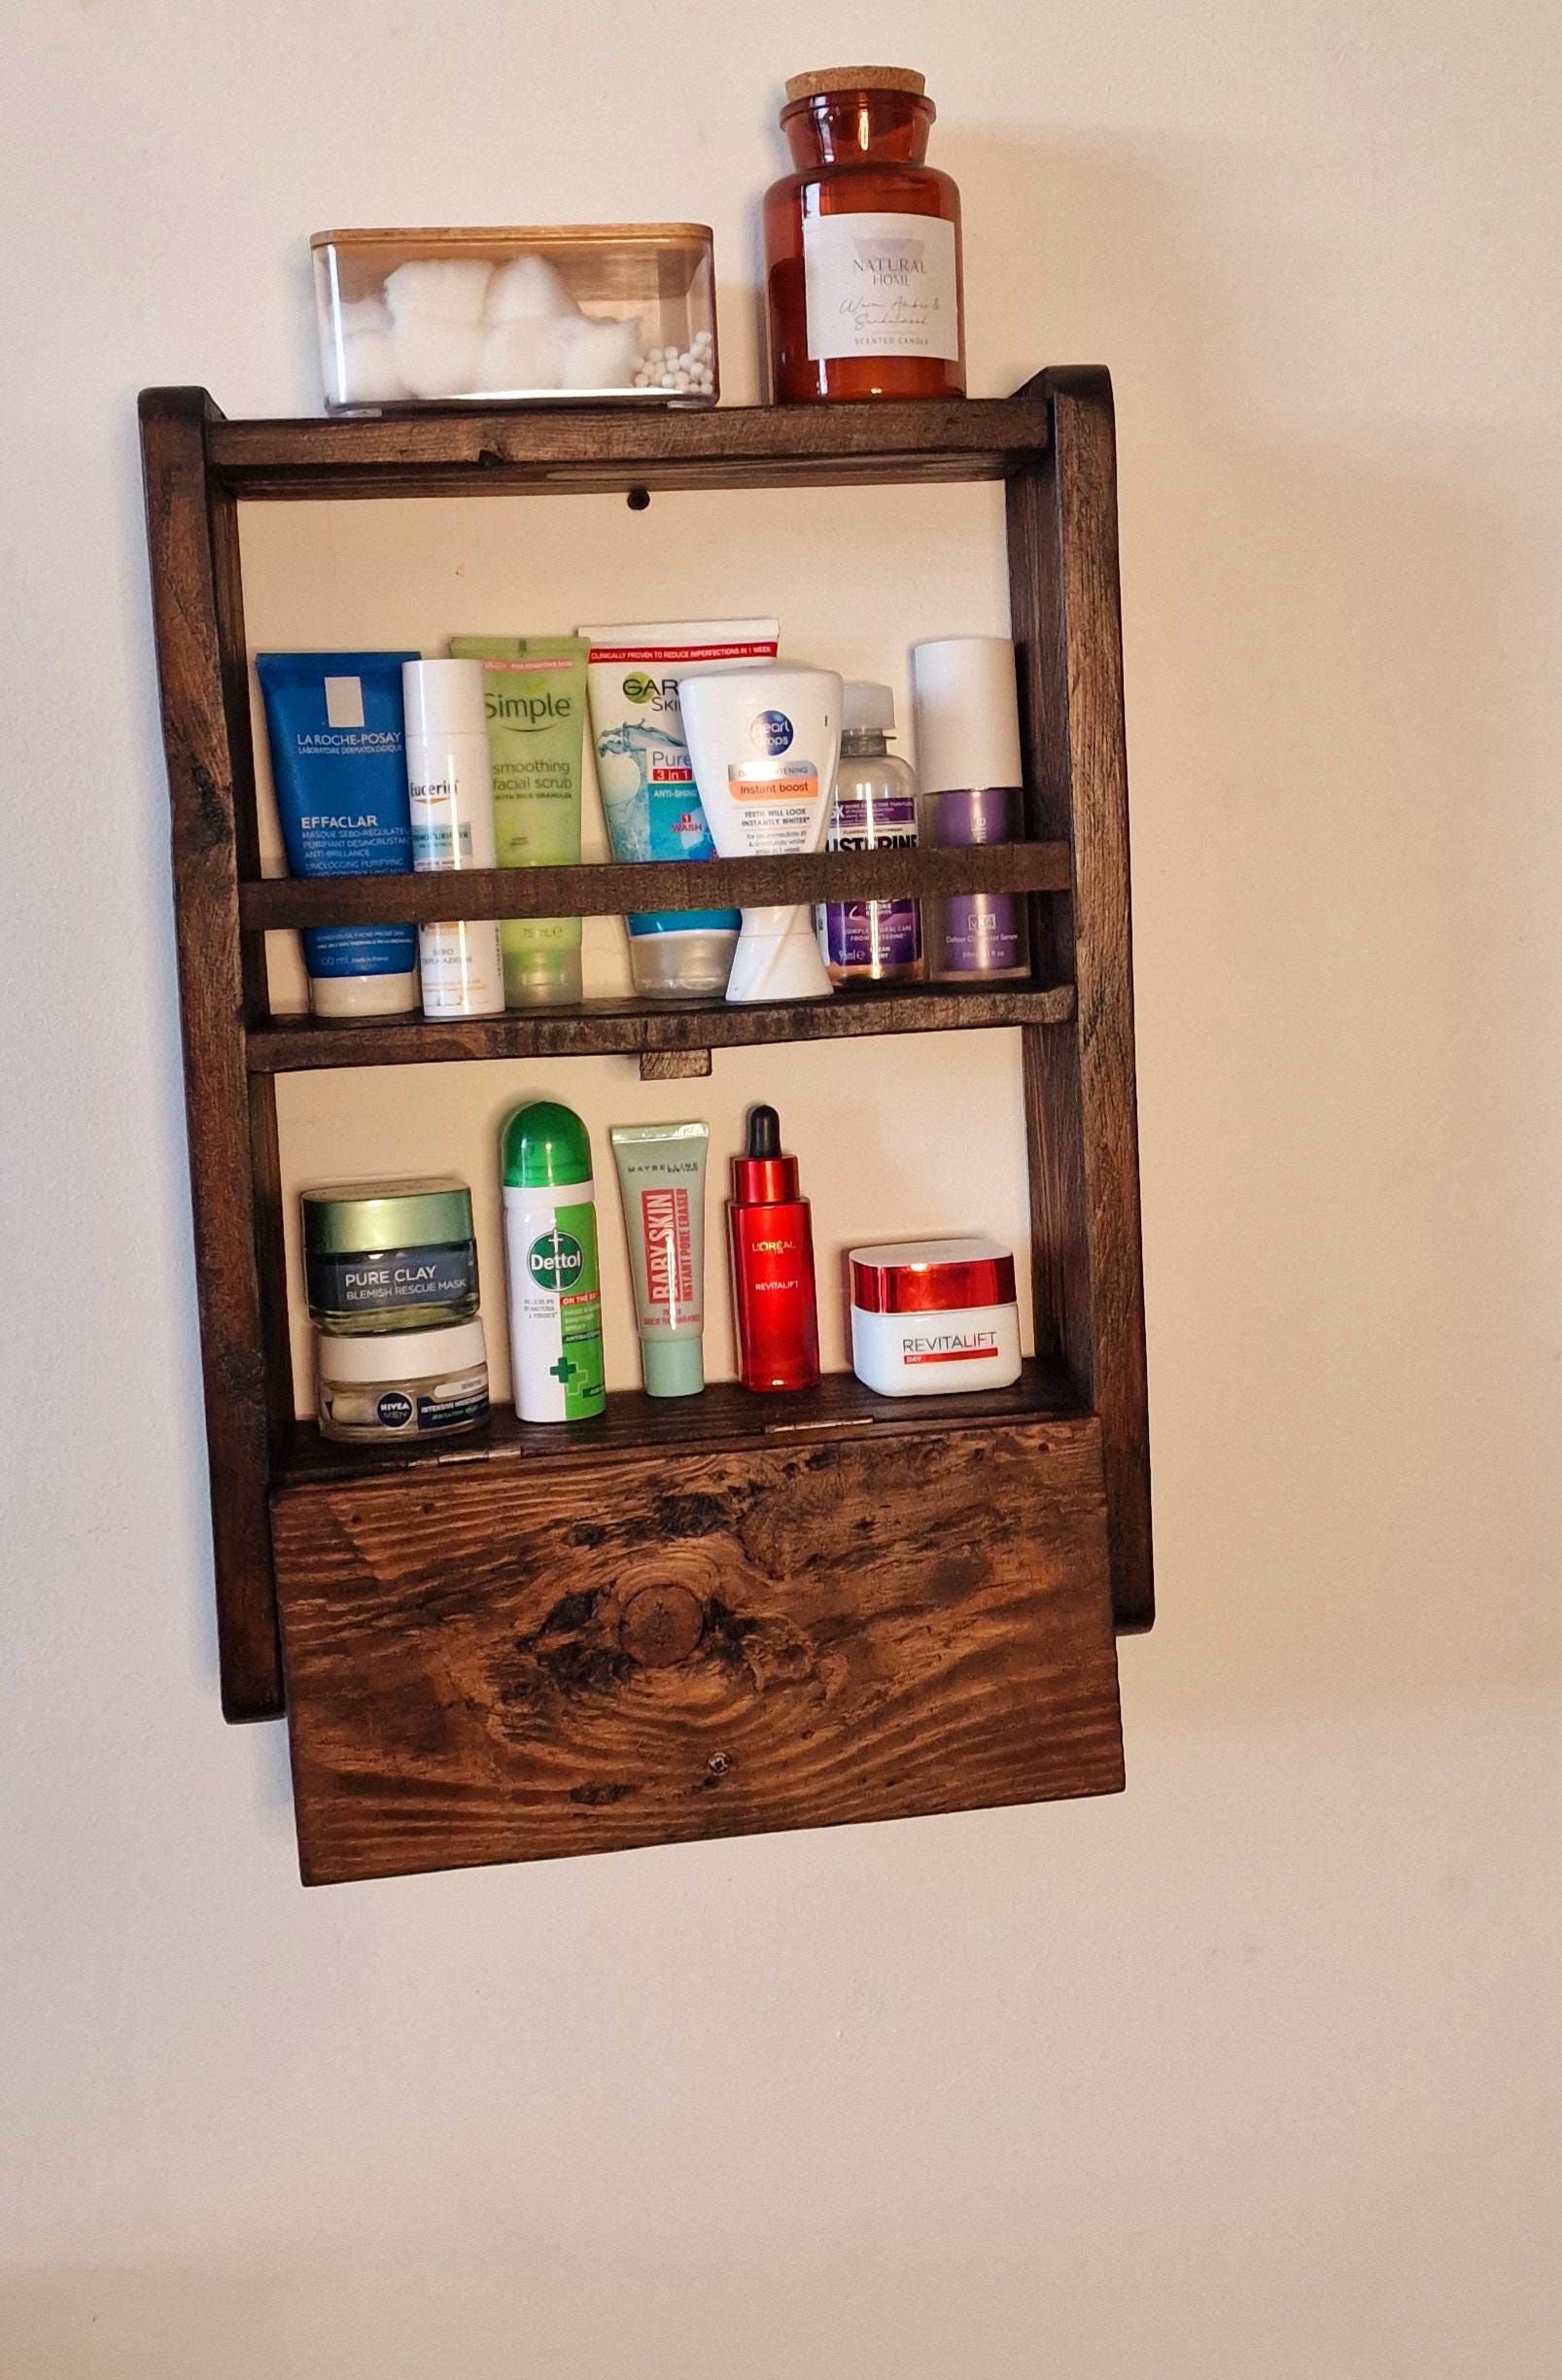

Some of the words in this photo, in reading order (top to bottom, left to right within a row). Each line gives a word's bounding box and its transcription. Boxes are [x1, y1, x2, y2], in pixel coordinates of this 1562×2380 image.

[854, 259, 927, 273] NATURAL
[873, 273, 910, 286] HOME
[855, 336, 894, 345] SCENTED
[898, 336, 928, 345] CANDLE
[591, 651, 627, 660] CLINICALLY
[628, 650, 653, 659] PROVEN
[664, 649, 689, 659] REDUCE
[690, 648, 740, 657] IMPERFECTIONS
[622, 679, 679, 696] GAR
[484, 692, 571, 724] Simple
[314, 731, 401, 746] ROCHE-POSAY
[652, 751, 693, 767] Pure
[493, 759, 571, 775] smoothing
[656, 769, 666, 781] 3
[683, 769, 689, 781] 1
[493, 777, 530, 791] facial
[535, 778, 573, 789] scrub
[740, 784, 777, 794] Instant
[780, 782, 809, 792] boost
[785, 808, 807, 817] LOOK
[300, 815, 379, 829] EFFACLAR
[672, 823, 702, 832] WASH
[628, 1162, 699, 1173] MAYBELLINE
[646, 1194, 675, 1242] SKIN
[531, 1251, 581, 1271] Dettol
[345, 1271, 391, 1287] PURE
[394, 1265, 437, 1282] CLAY
[649, 1244, 678, 1300] BABY
[346, 1287, 393, 1301] BLEMISH
[395, 1282, 436, 1296] RESCUE
[437, 1278, 468, 1291] MASK
[755, 1279, 799, 1291] REVITALIFT
[902, 1331, 997, 1352] REVITALIFT
[380, 1402, 410, 1412] NIVEA
